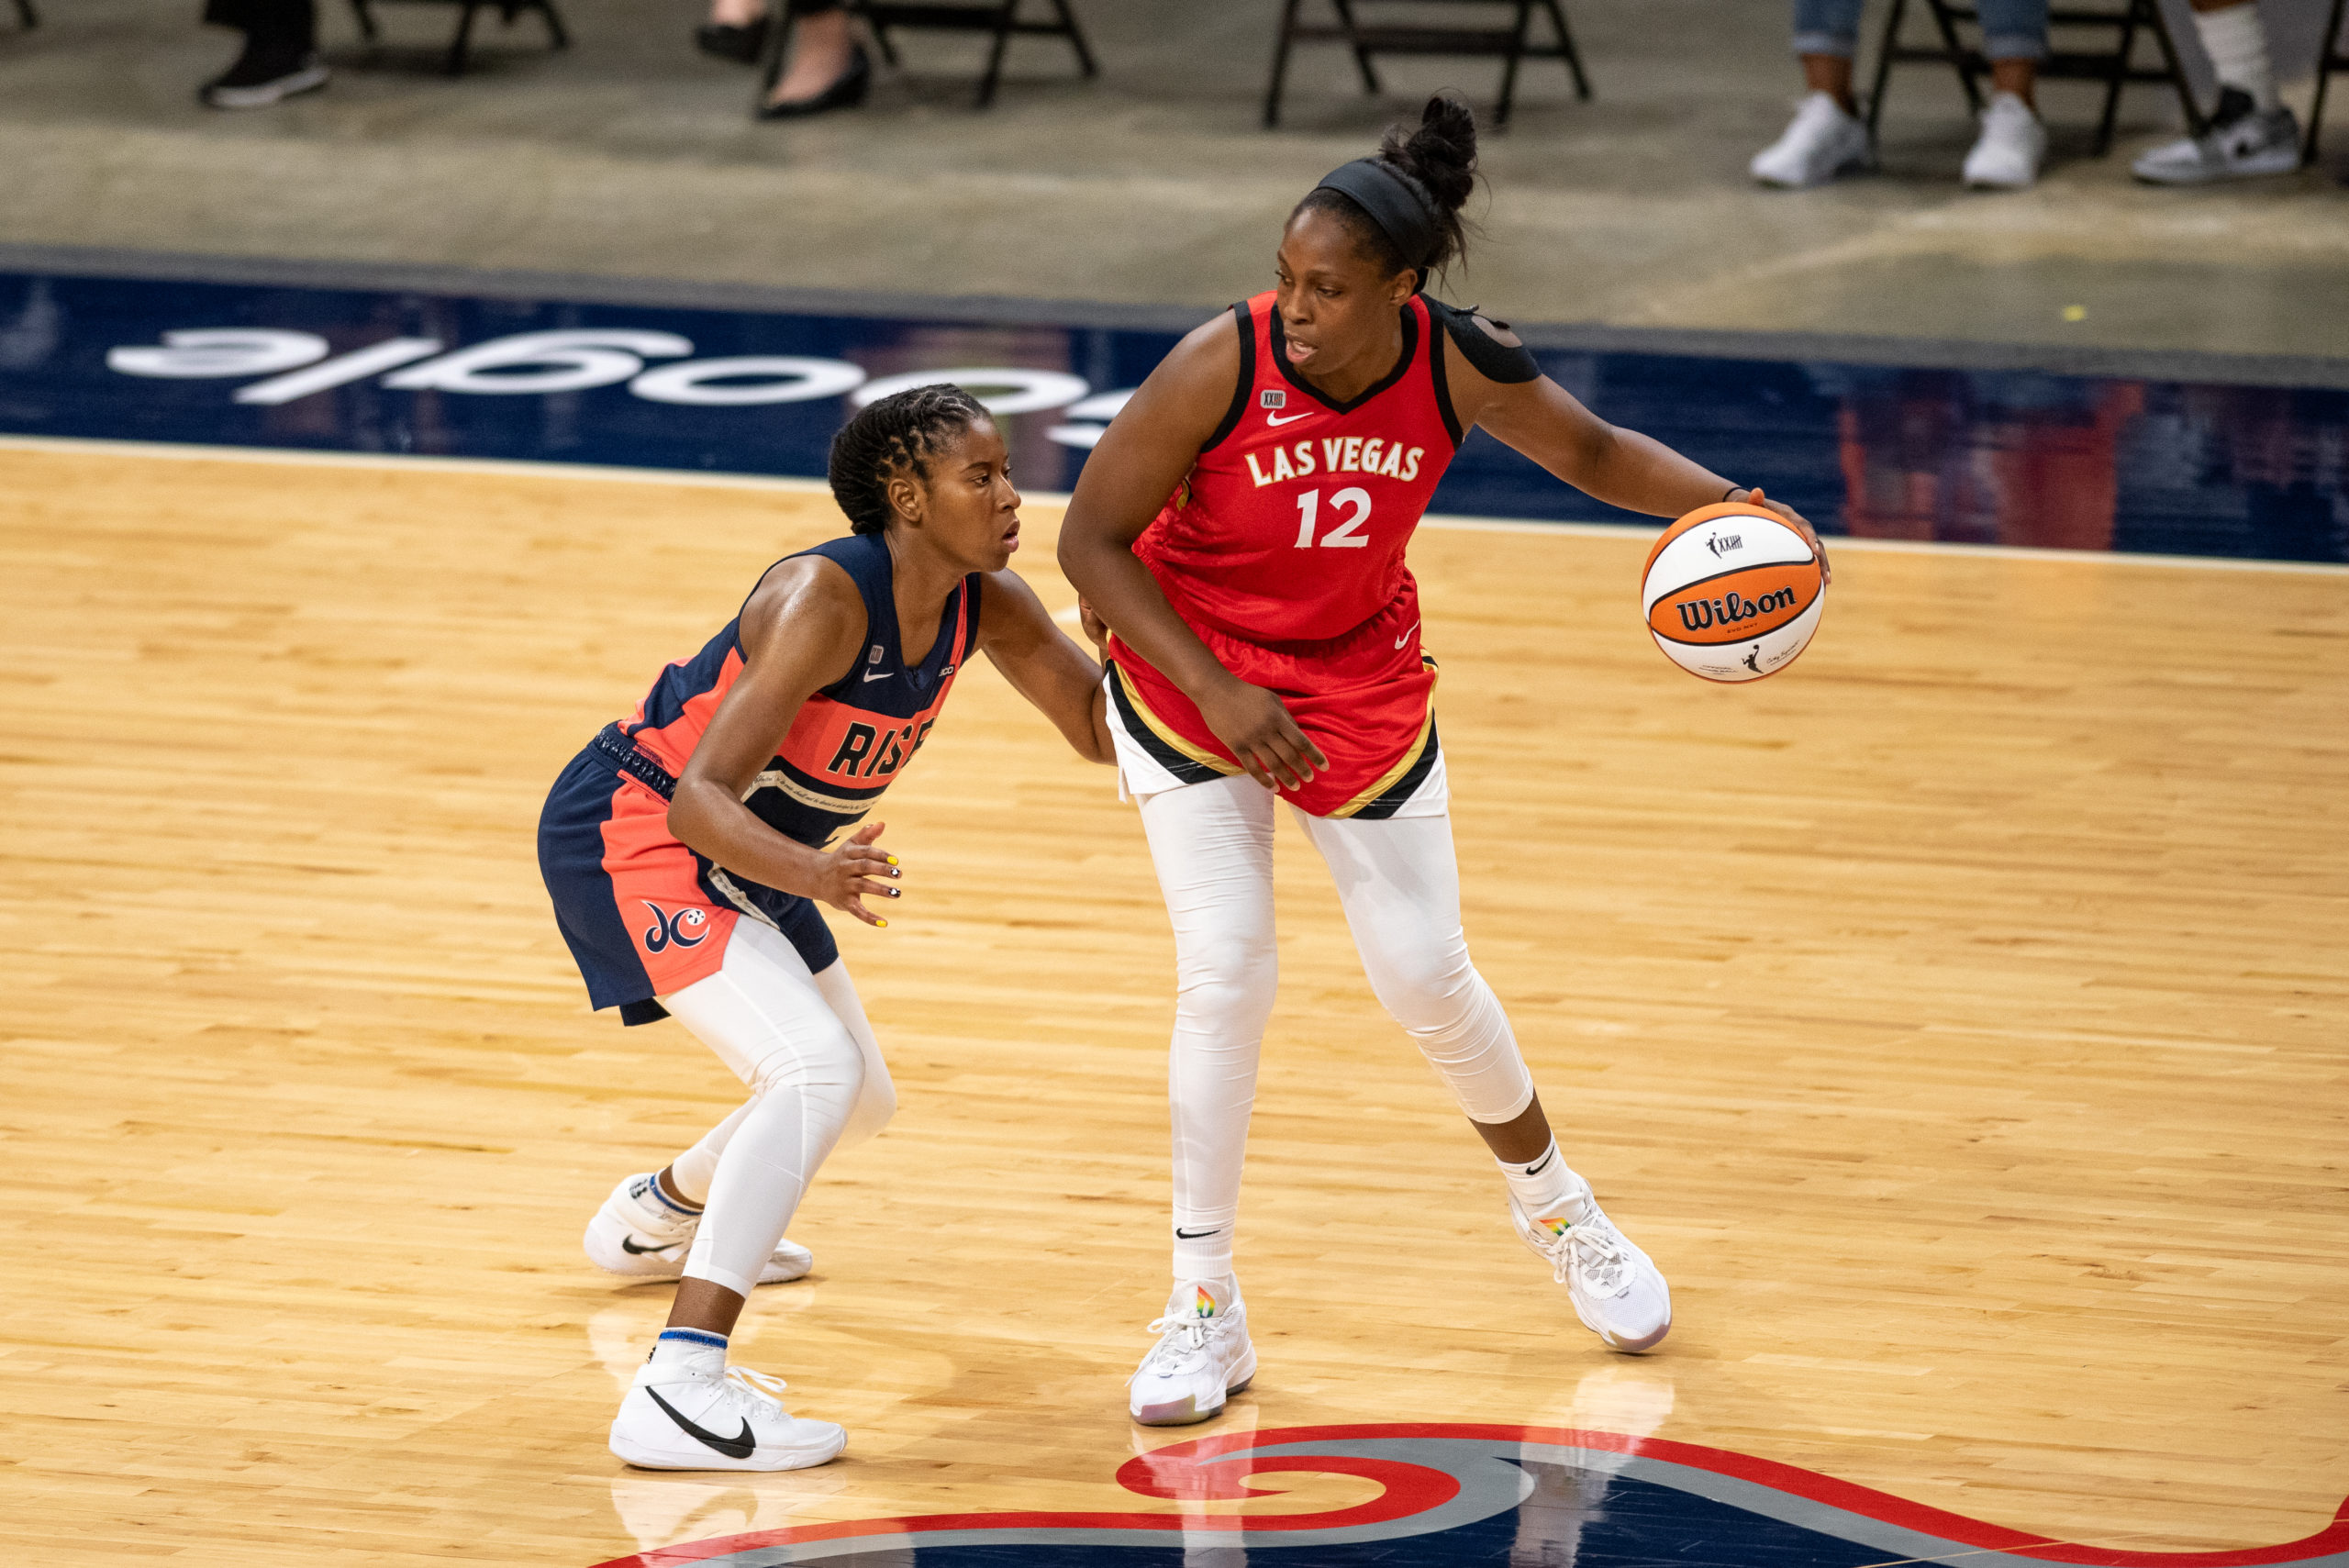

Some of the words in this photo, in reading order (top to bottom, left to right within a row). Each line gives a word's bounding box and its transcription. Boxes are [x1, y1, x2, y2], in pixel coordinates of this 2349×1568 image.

[106, 327, 1138, 450] oogle
[1244, 440, 1317, 487] LAS
[1321, 437, 1425, 482] VEGAS
[1294, 487, 1372, 549] 12
[1676, 585, 1797, 632] Wilson
